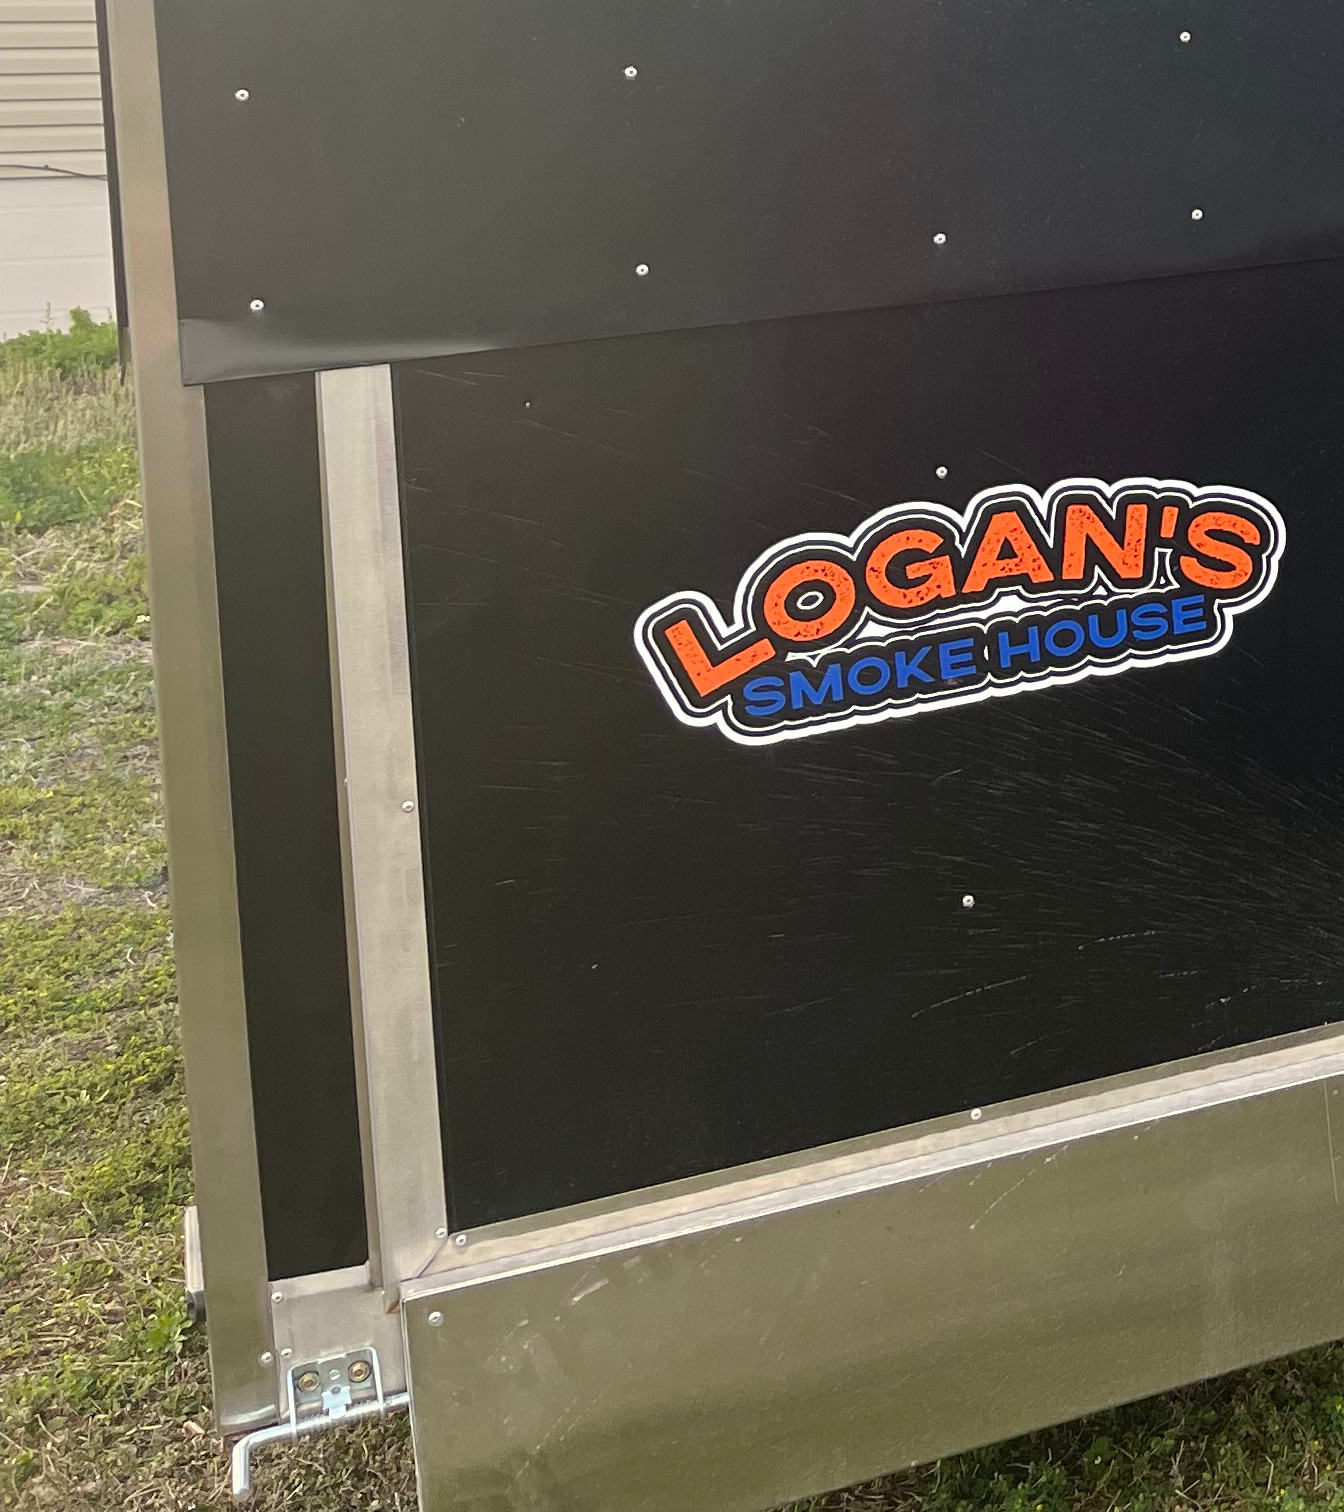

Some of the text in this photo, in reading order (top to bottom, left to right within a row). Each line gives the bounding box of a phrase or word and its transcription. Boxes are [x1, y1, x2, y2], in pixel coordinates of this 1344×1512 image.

[663, 503, 1262, 697] LOGAN'S
[742, 593, 1208, 718] SMOKE HOUSE
